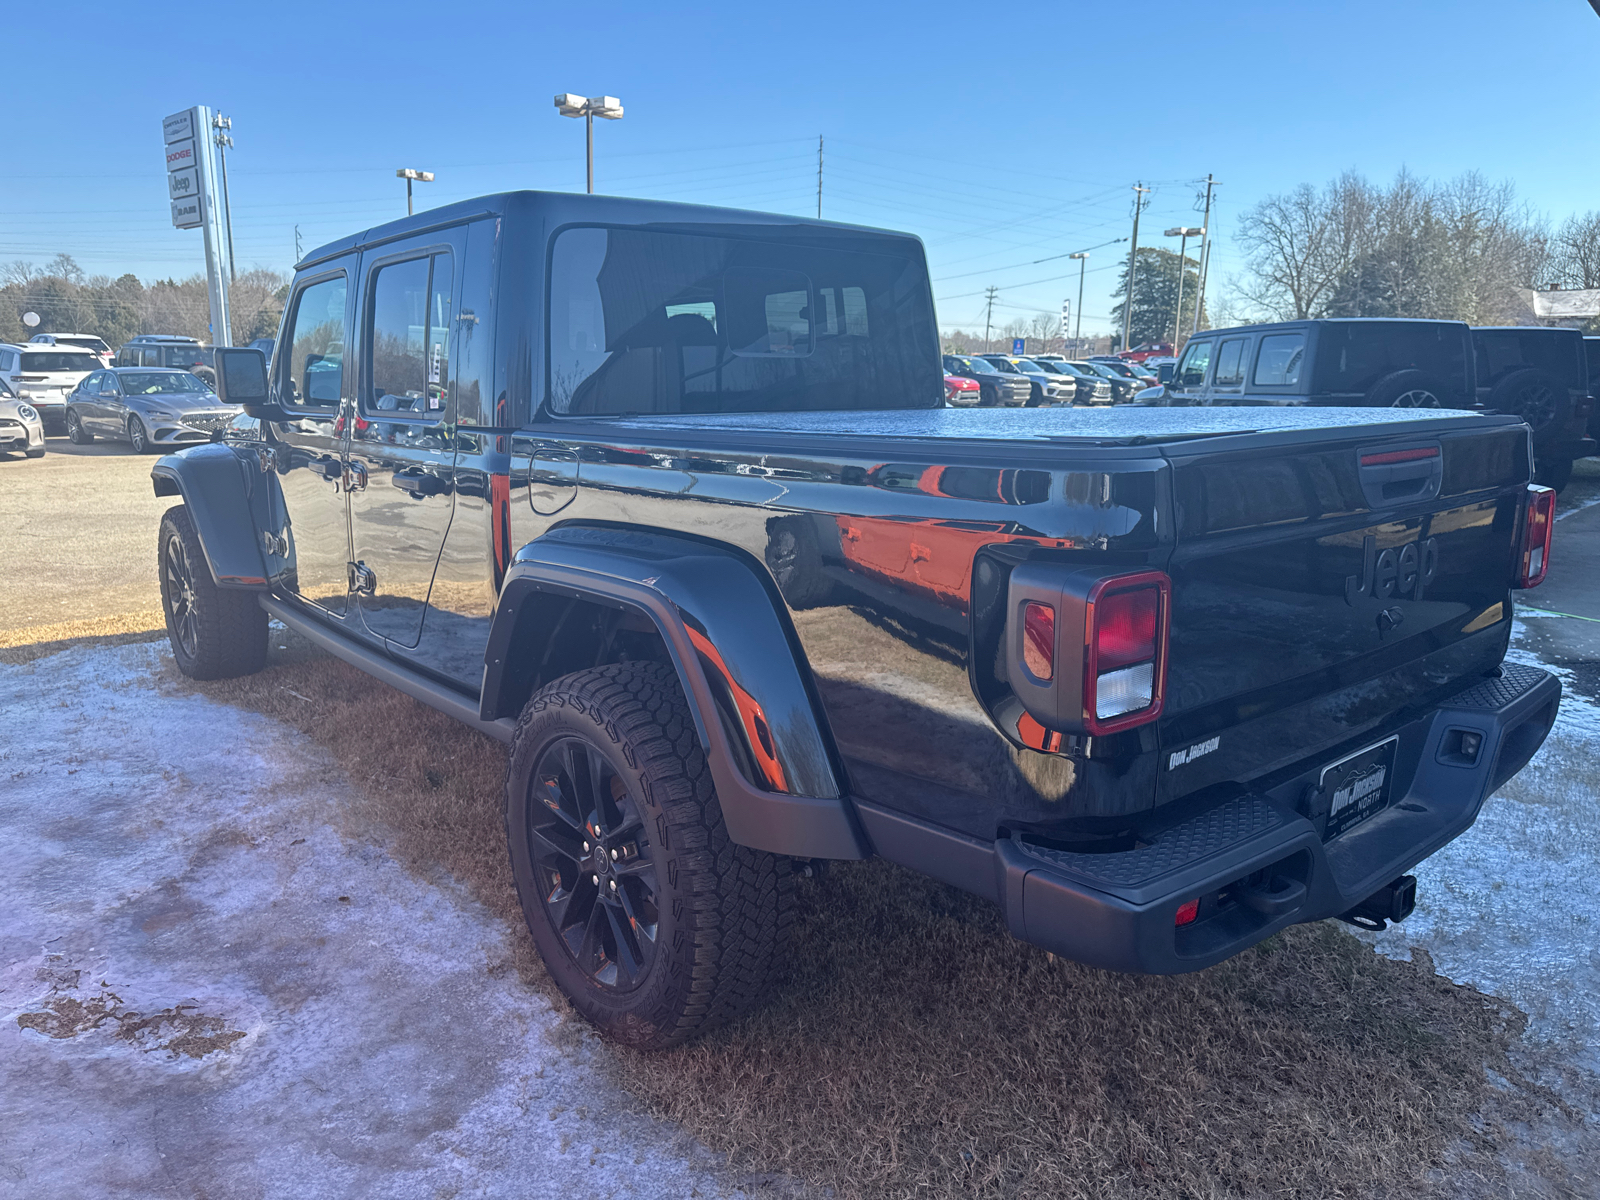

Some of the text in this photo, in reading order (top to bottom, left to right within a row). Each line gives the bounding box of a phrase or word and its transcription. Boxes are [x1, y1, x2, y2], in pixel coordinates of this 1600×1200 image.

[164, 117, 187, 129] CHRYSLER
[166, 149, 191, 163] DODGE
[172, 175, 190, 193] Jeep
[177, 205, 197, 217] RAM
[1344, 535, 1439, 607] Jeep
[512, 711, 564, 780] GENERAL
[1357, 789, 1381, 812] NORTH
